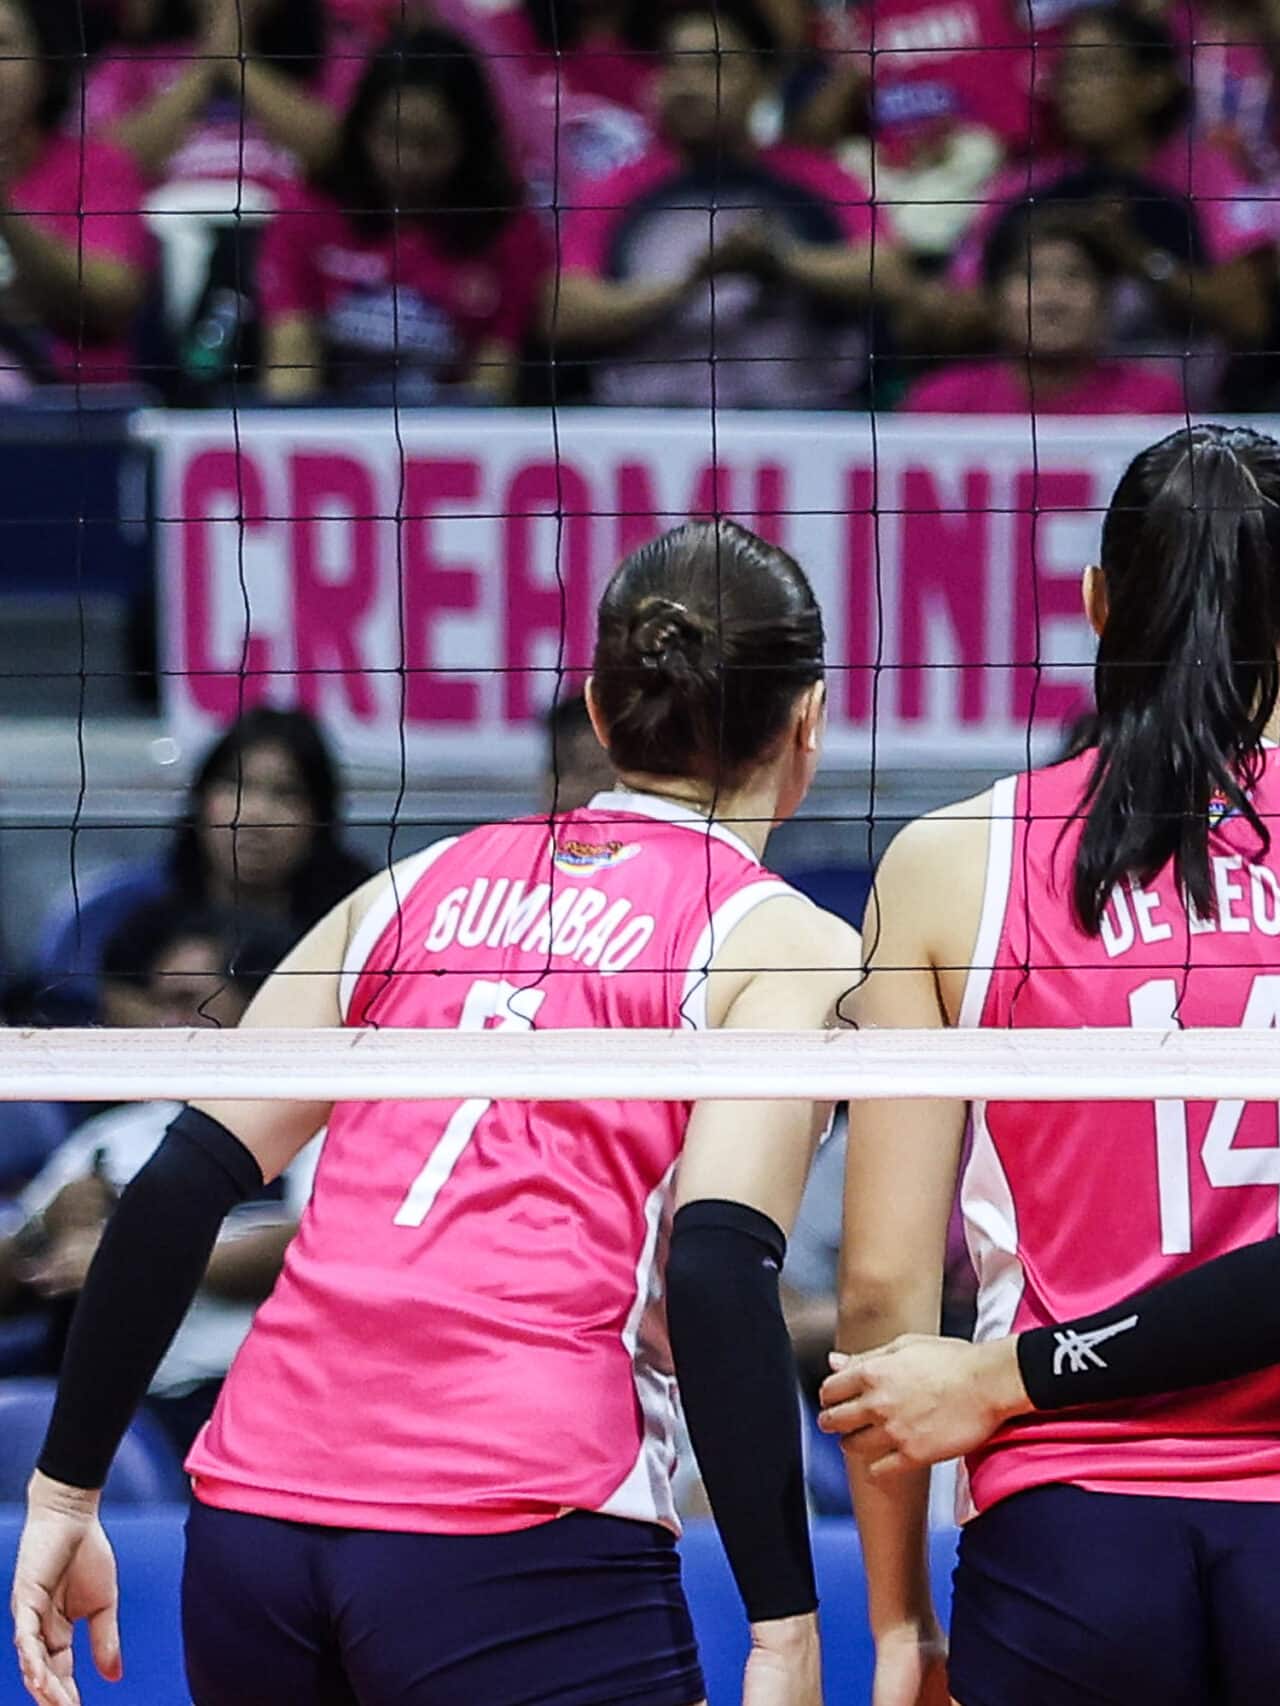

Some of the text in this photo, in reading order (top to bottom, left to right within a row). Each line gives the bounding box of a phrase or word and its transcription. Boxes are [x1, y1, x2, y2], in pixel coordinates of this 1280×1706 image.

[181, 448, 1095, 726] CREAINE
[424, 877, 655, 976] GUMABAO
[393, 979, 546, 1227] 7
